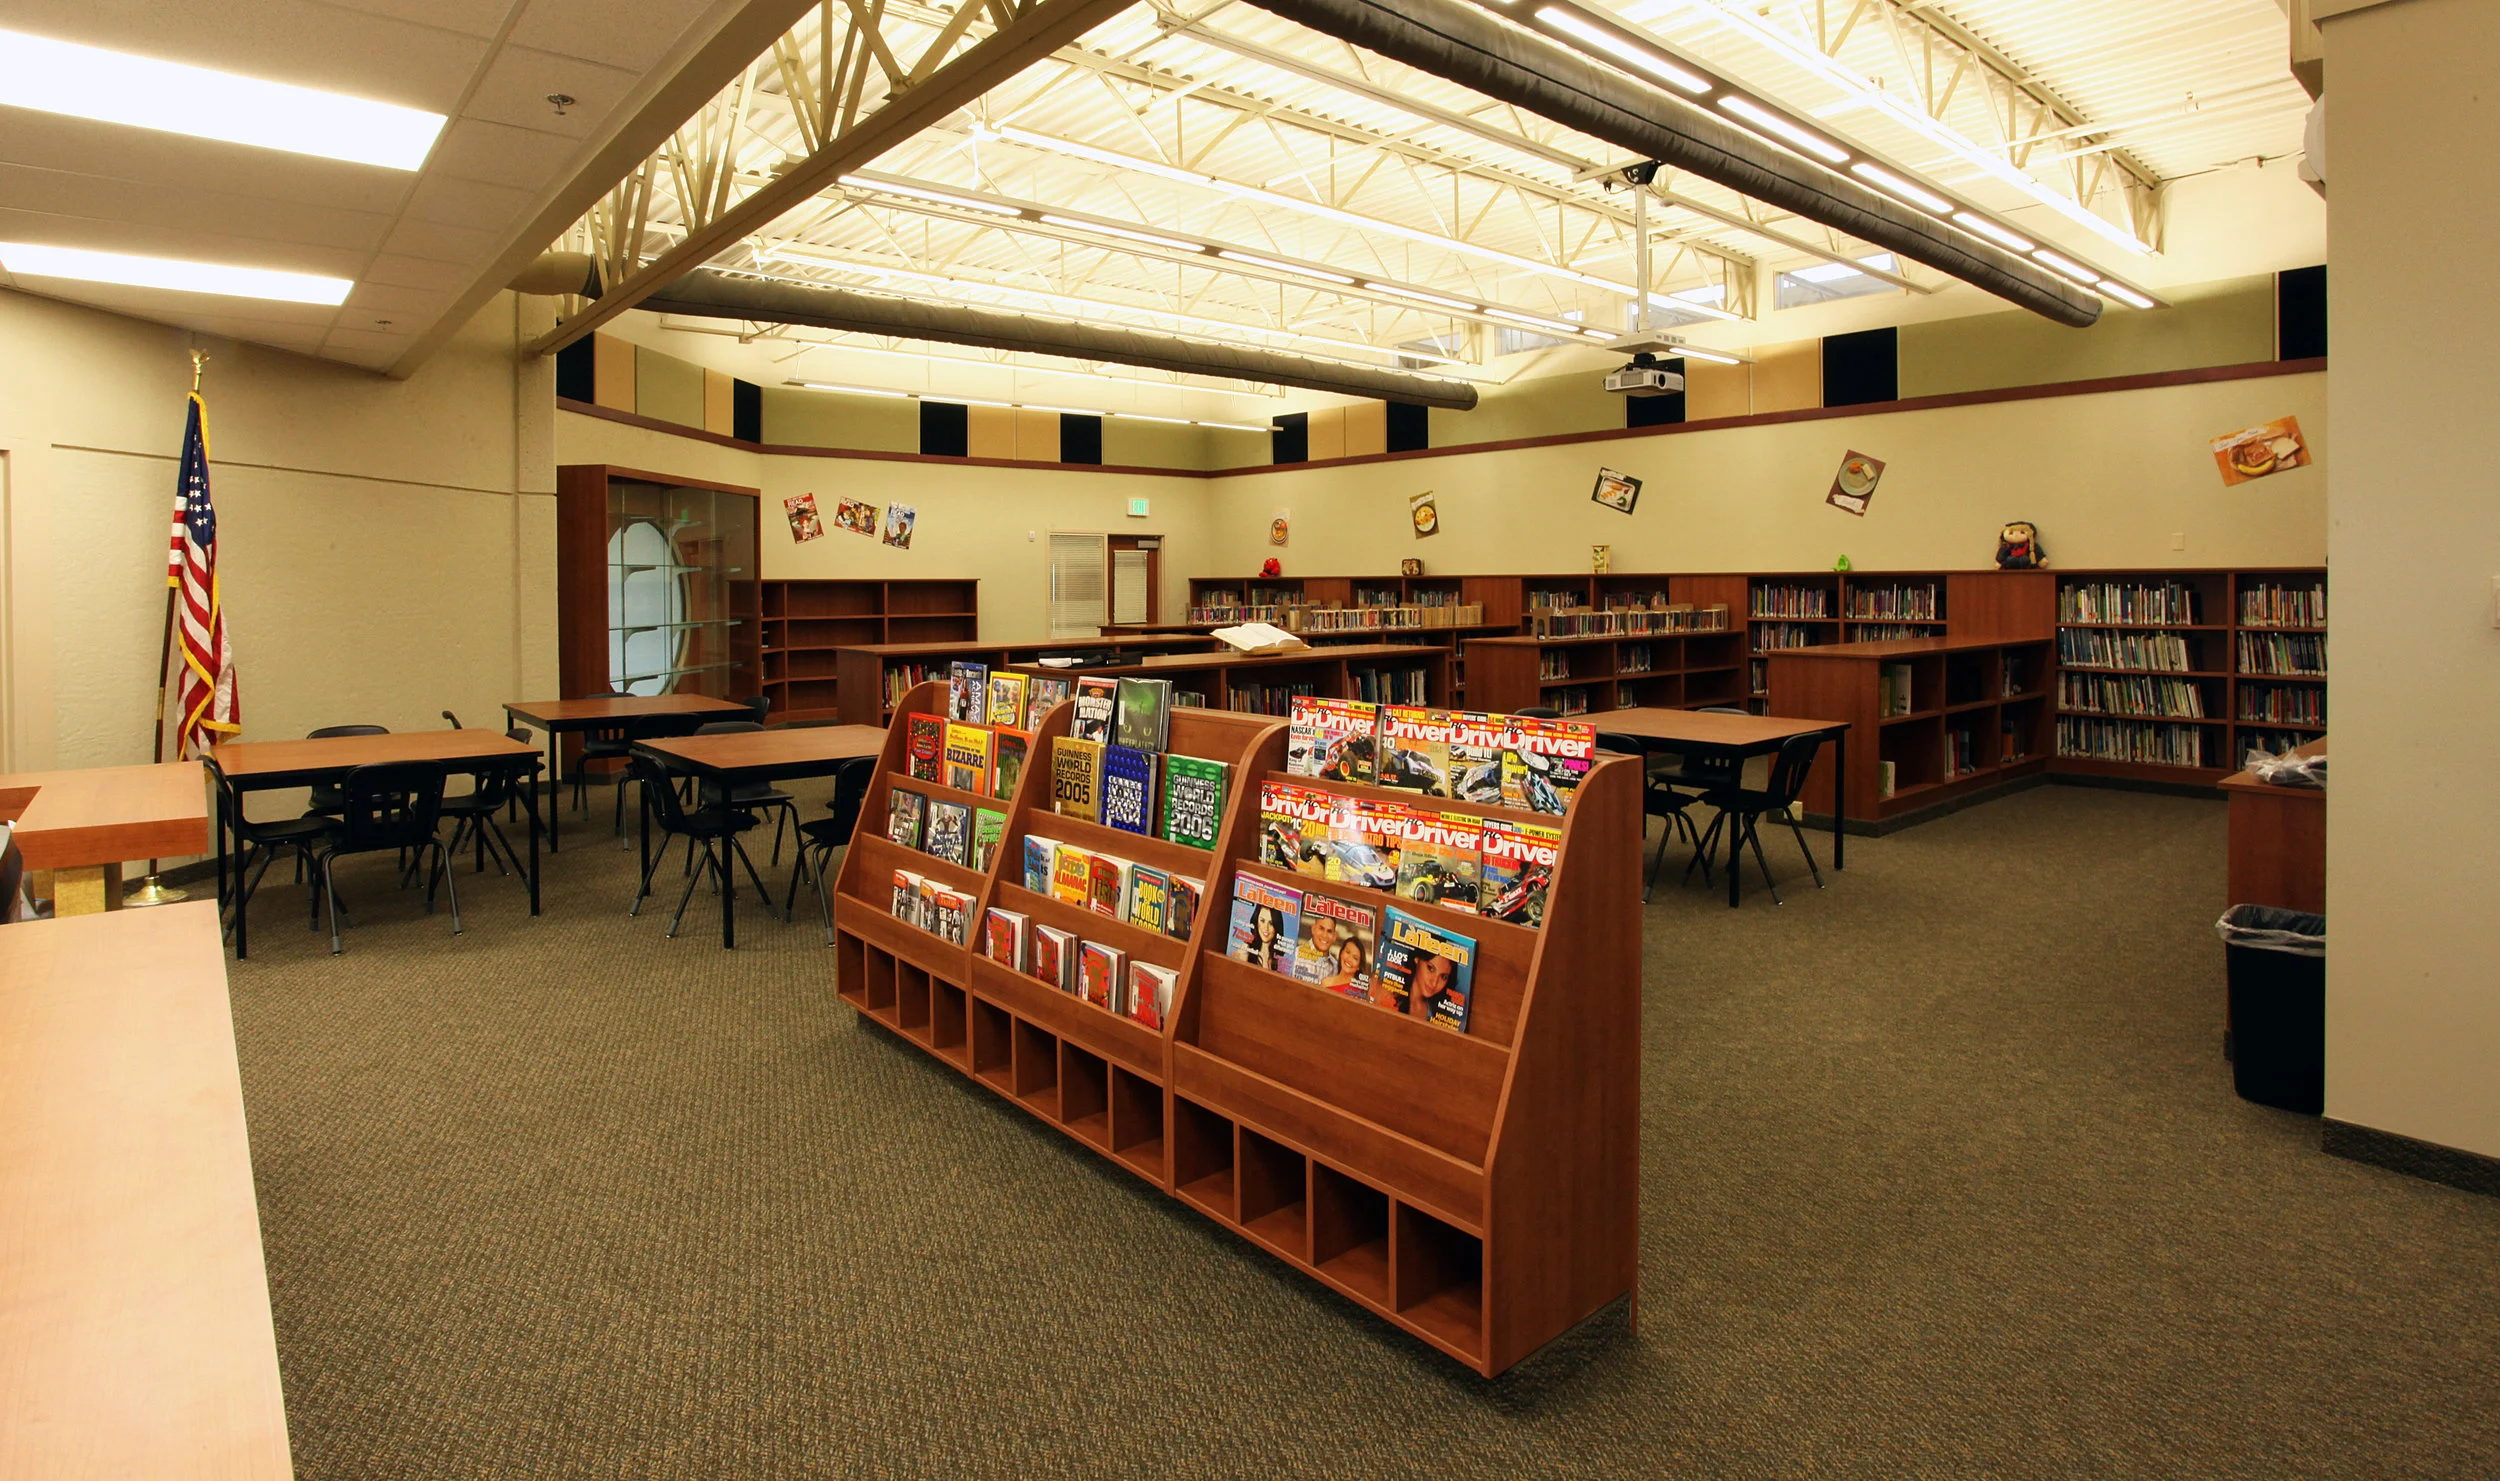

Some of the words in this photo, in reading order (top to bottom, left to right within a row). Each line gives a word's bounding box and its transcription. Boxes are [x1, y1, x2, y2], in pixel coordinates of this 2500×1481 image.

[1078, 695, 1112, 711] MONSTER
[1079, 707, 1108, 721] NATION
[1316, 708, 1375, 735] Driver
[1291, 726, 1312, 735] NASCAR
[1384, 717, 1450, 743] Driver
[1450, 722, 1503, 748] Driv
[1503, 726, 1591, 758] Driver
[946, 748, 984, 768] BIZARRE
[1057, 748, 1092, 761] GUINNESS
[1057, 757, 1092, 774] WORLD
[1564, 759, 1590, 772] PINKS!
[1056, 769, 1091, 784] RECORDS
[1173, 774, 1216, 791] GUINNESS
[1055, 779, 1090, 804] 2005
[1173, 785, 1215, 804] WORLD
[1171, 797, 1214, 817] RECORDS
[1261, 792, 1303, 816] Driv
[1170, 809, 1213, 841] 2006
[1301, 820, 1316, 837] 20
[1330, 808, 1405, 835] Driver
[1403, 818, 1480, 850] Driver
[1525, 828, 1545, 838] E-POWER
[1386, 835, 1402, 849] TIPS
[1327, 857, 1341, 866] 20
[1054, 870, 1087, 893] ALMANAC
[1139, 881, 1158, 904] BOOK
[1387, 953, 1402, 965] LOOK
[1384, 971, 1405, 984] PITBULL
[1435, 1012, 1461, 1026] HOLIDAY
